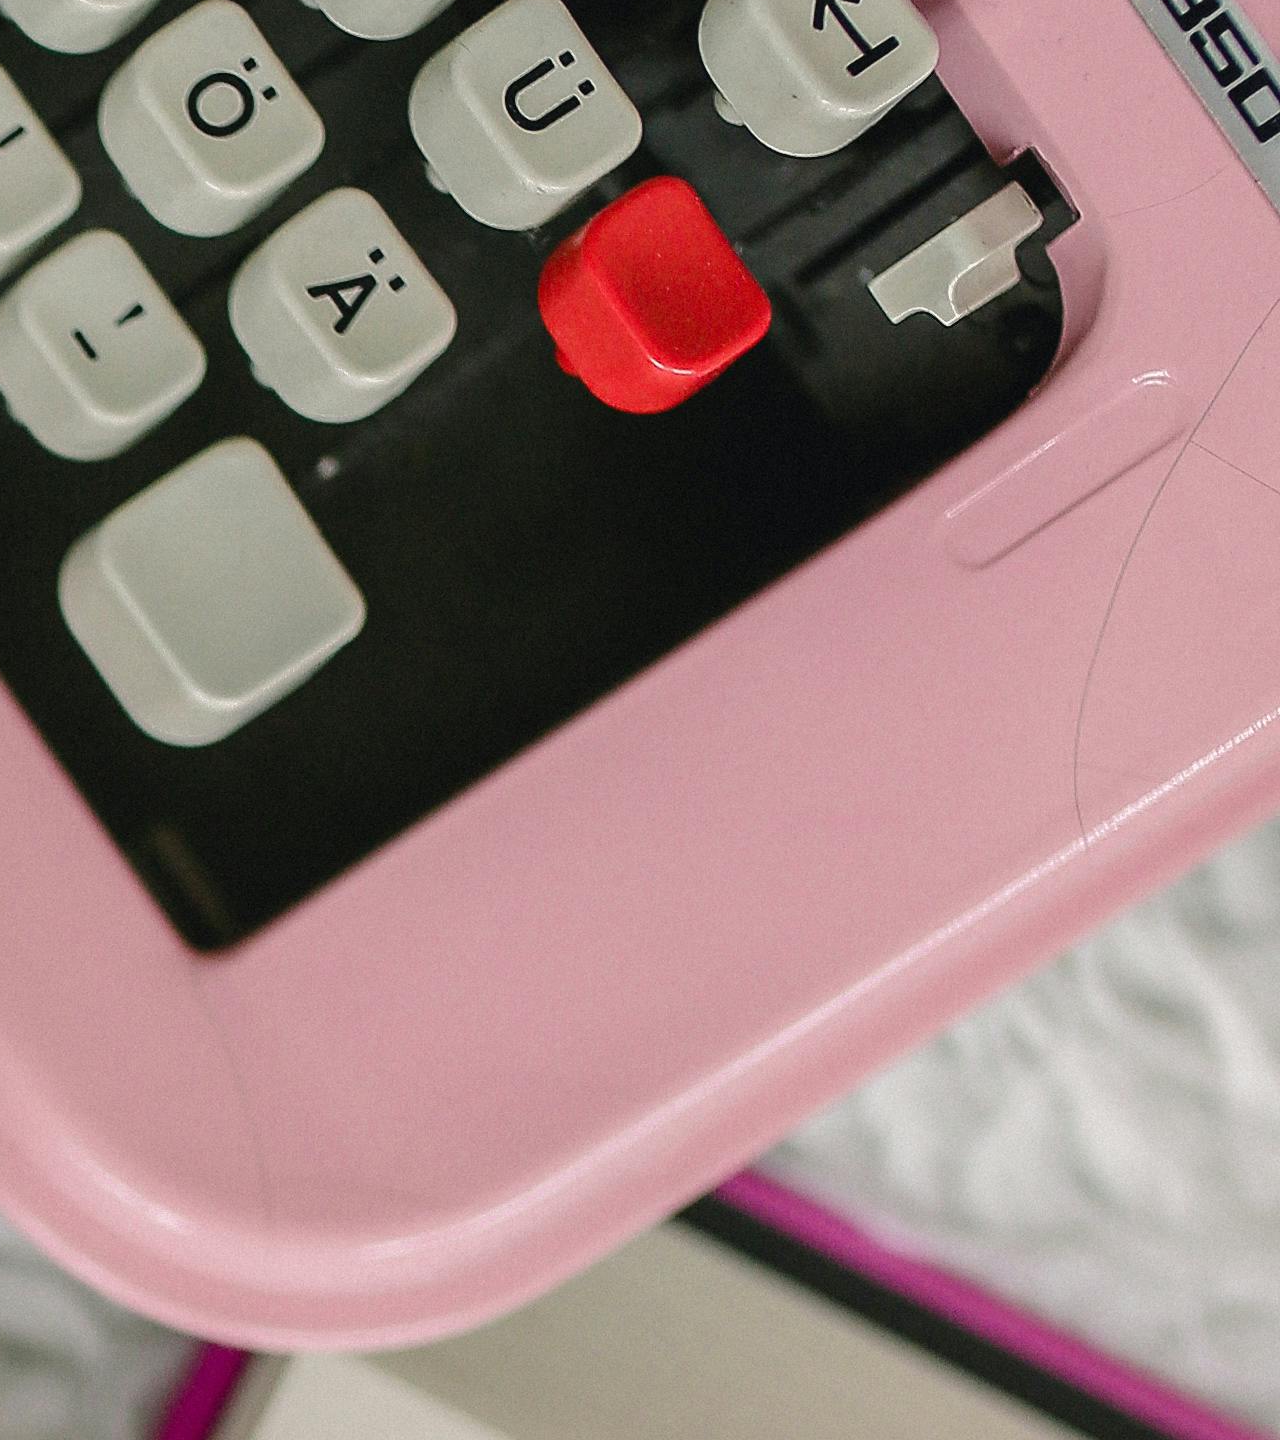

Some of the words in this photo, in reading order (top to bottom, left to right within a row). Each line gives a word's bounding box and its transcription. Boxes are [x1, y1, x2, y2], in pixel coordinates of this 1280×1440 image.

[186, 57, 277, 138] Ö
[504, 51, 595, 132] Ü
[306, 248, 405, 335] Ä
